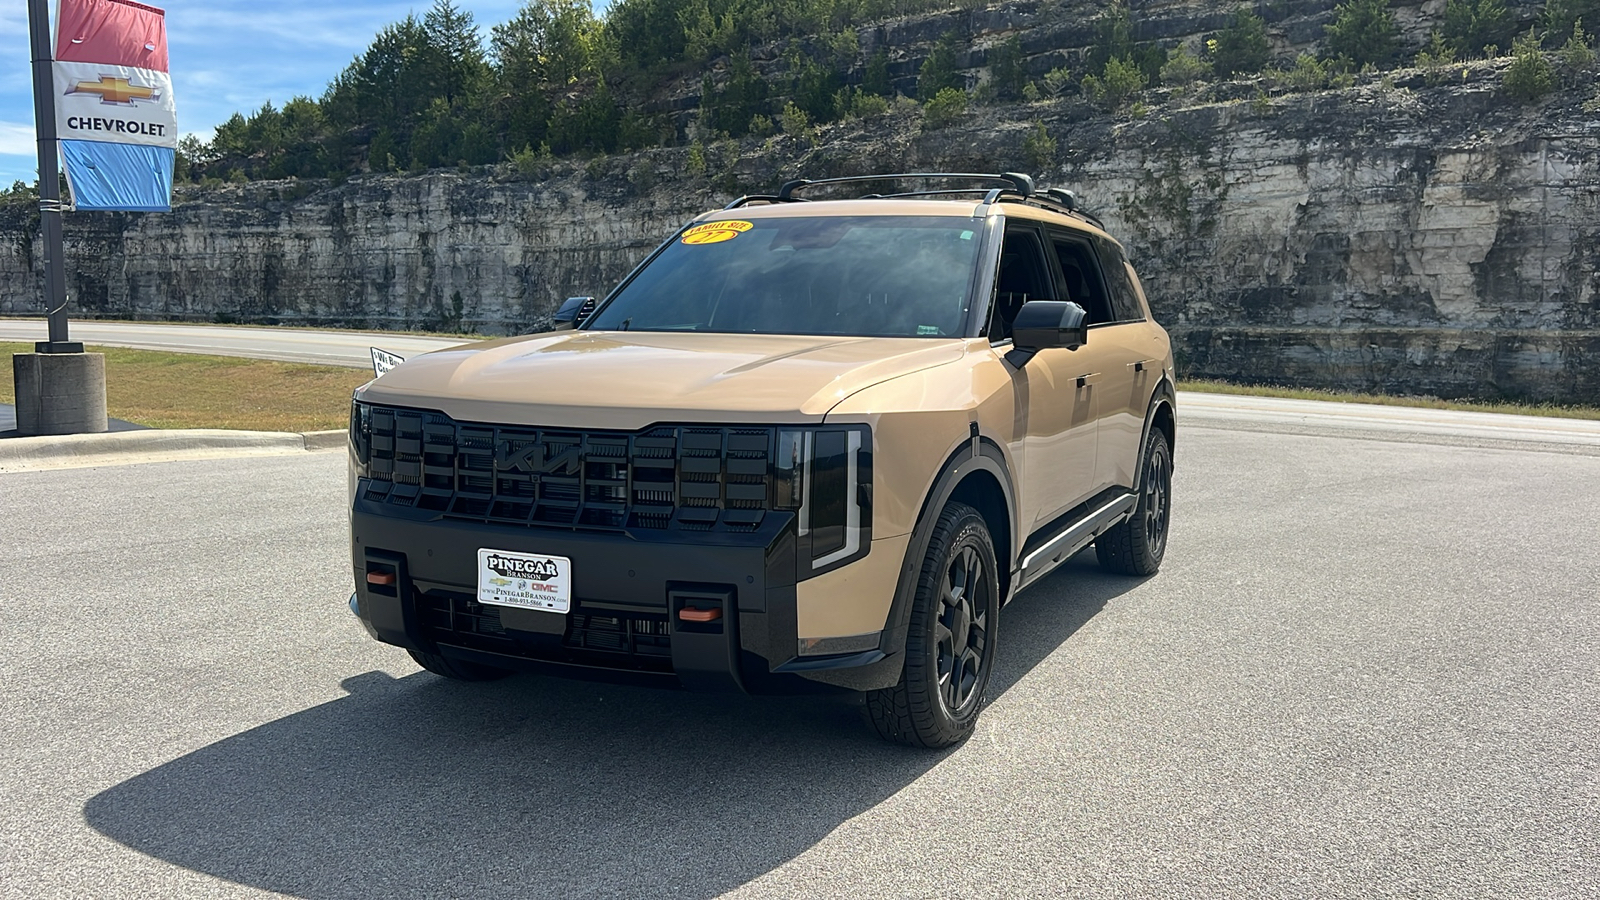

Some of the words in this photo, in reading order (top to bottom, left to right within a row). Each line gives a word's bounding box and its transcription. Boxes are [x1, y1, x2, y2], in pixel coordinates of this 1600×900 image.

[67, 116, 165, 137] CHEVROLET
[690, 222, 726, 234] FAMILY
[727, 221, 750, 230] SIZE
[495, 441, 580, 475] KIA
[488, 557, 557, 576] PINEGAR
[506, 570, 542, 580] BRANSON
[531, 582, 559, 593] GMC
